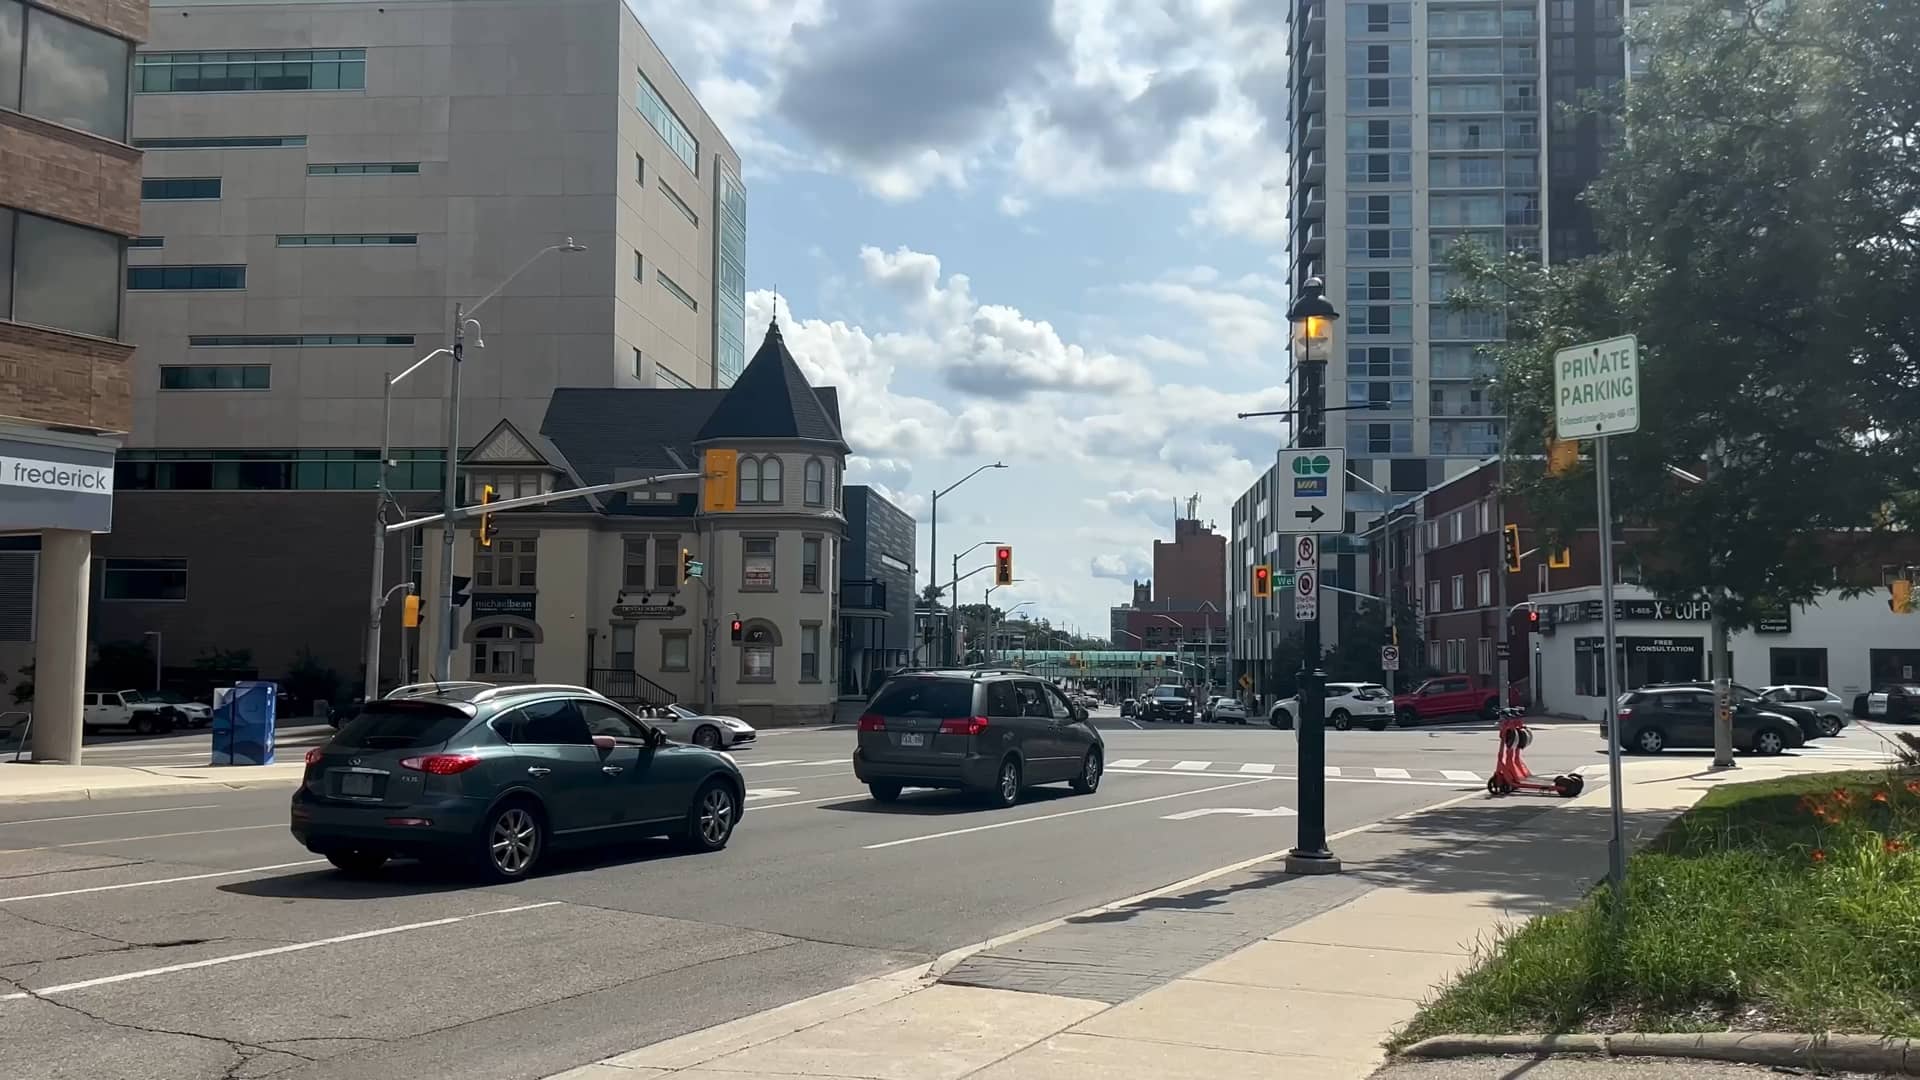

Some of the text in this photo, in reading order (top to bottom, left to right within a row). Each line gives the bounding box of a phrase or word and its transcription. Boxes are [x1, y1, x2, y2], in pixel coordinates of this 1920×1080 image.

[1561, 348, 1631, 380] PRIVATE
[1560, 376, 1634, 407] PARKING
[13, 462, 107, 490] frederick
[1675, 601, 1711, 619] COPP
